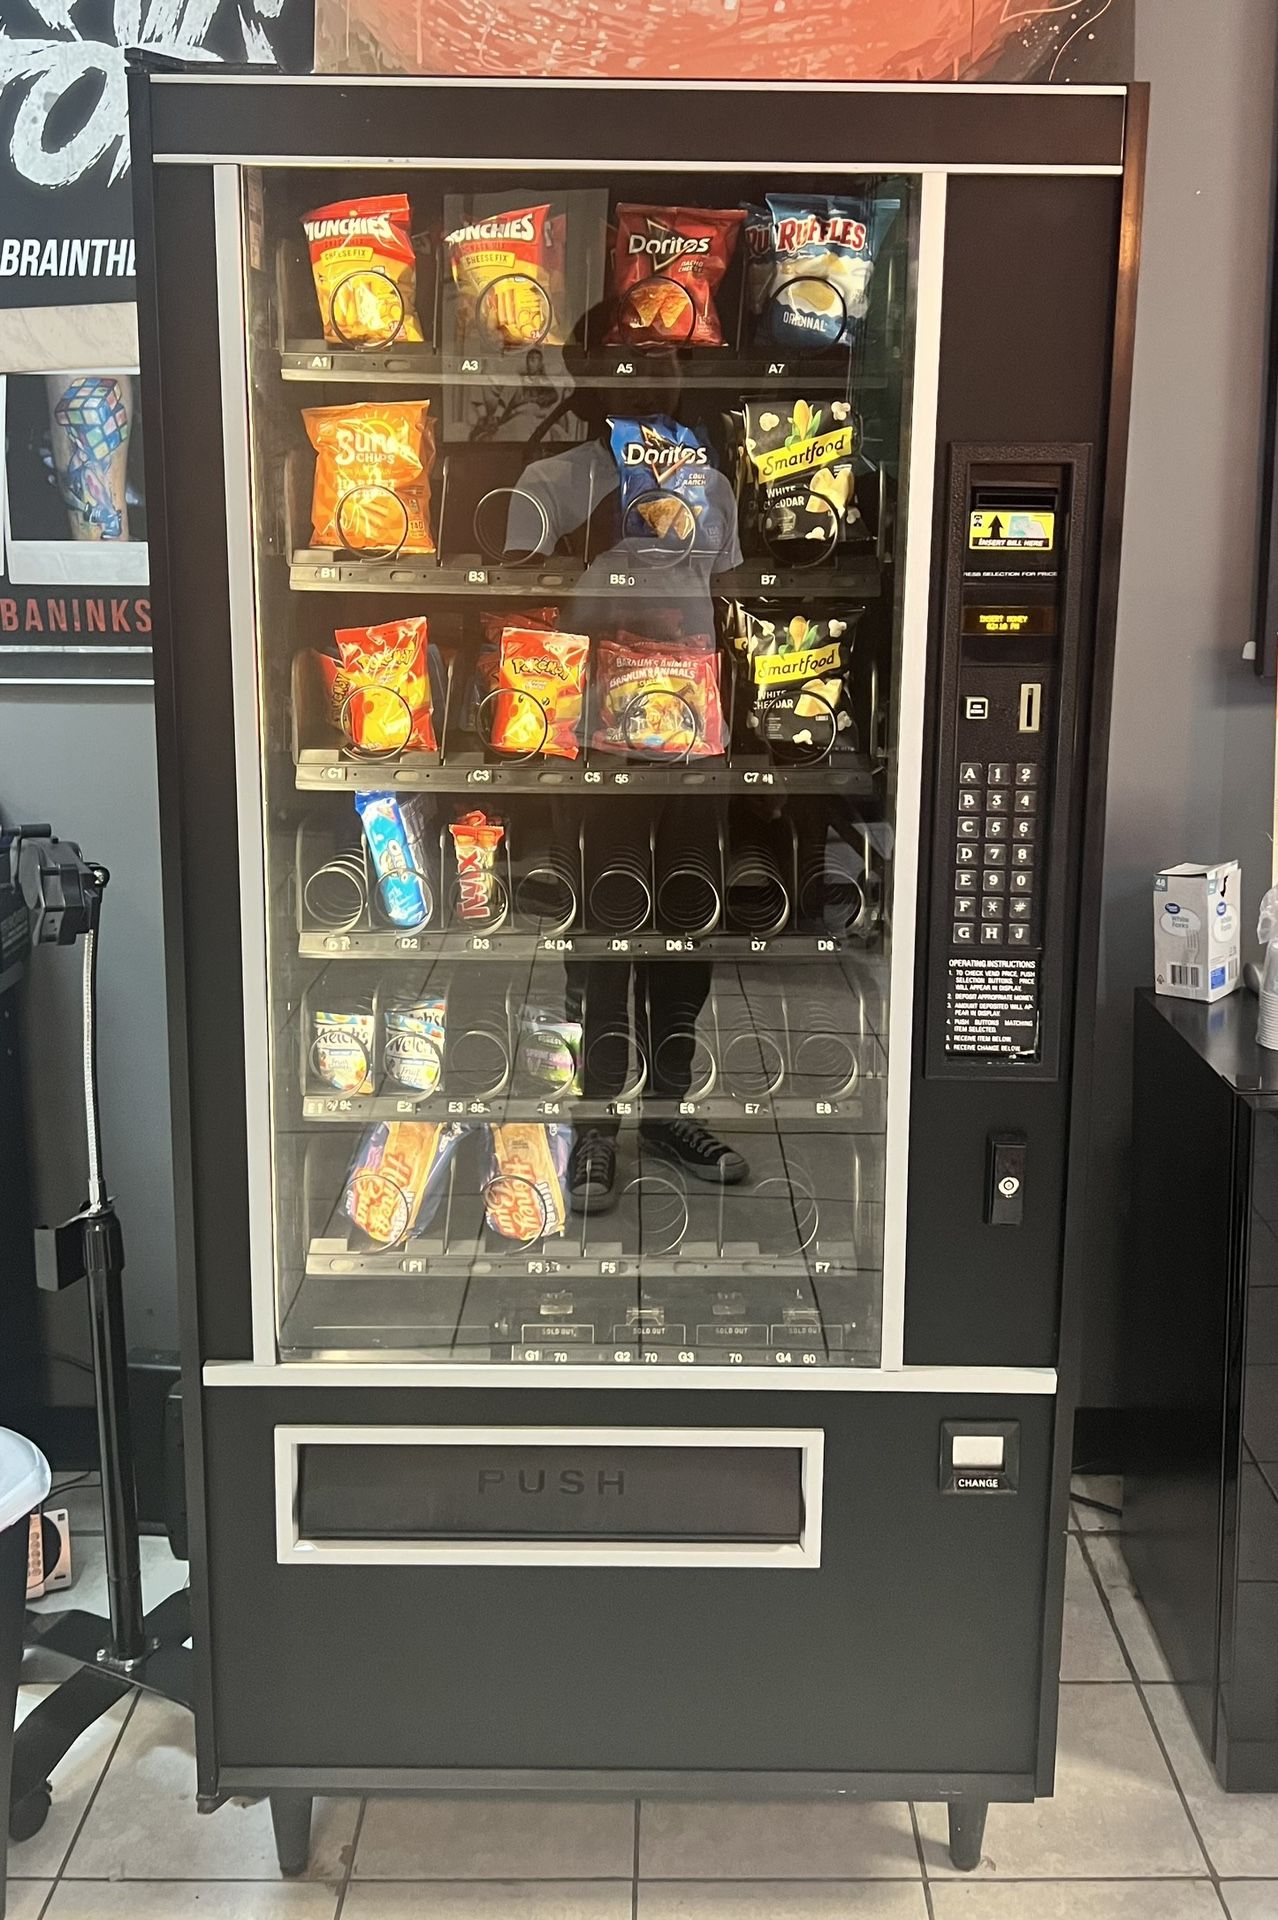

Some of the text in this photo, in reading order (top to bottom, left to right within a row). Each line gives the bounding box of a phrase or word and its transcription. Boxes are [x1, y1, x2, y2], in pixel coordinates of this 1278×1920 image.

[304, 213, 392, 241] MUNCHIES
[444, 213, 534, 243] UNCHIES
[776, 214, 866, 253] RUFFLES
[629, 234, 710, 254] Doritos
[353, 249, 366, 257] FIX
[466, 254, 507, 265] CHEESE FIX
[311, 357, 327, 368] A1
[462, 360, 479, 371] A3
[616, 363, 633, 374] A5
[768, 363, 785, 374] A7
[356, 454, 395, 464] CHIPS
[627, 444, 707, 466] Doritos
[763, 435, 845, 476] Smartfood
[978, 538, 1006, 546] INSERT
[321, 569, 335, 578] B1
[469, 571, 485, 582] B3
[610, 574, 625, 584] B5
[761, 575, 776, 585] B7
[2, 598, 152, 632] BANINKS
[1006, 615, 1028, 623] MONEY
[758, 650, 835, 678] Smartfood
[327, 768, 342, 778] C1
[473, 770, 489, 781] C3
[584, 772, 600, 783] C5
[744, 772, 758, 783] C7
[963, 768, 1031, 779] A 1 2
[963, 795, 1029, 806] B 3 4
[961, 821, 1028, 832] C 5 6
[961, 848, 1027, 859] D 7 8
[960, 874, 1026, 886] E 9 0
[959, 901, 971, 911] F
[958, 927, 1024, 939] G H J
[401, 939, 418, 949] D2
[473, 939, 490, 950] D3
[557, 940, 572, 950] D4
[612, 940, 628, 951] D5
[666, 940, 682, 950] D6
[751, 940, 767, 951] D7
[817, 940, 834, 950] D8
[949, 959, 1036, 969] OPERATING INSTRUCTIONS
[397, 1101, 412, 1111] E2
[448, 1102, 463, 1112] E3
[544, 1103, 560, 1114] E4
[617, 1103, 632, 1114] E5
[680, 1103, 696, 1114] E6
[745, 1103, 760, 1114] E7
[816, 1103, 832, 1114] E8
[409, 1262, 422, 1272] F1
[528, 1262, 542, 1273] F3
[601, 1262, 615, 1273] F5
[815, 1262, 830, 1273] F7
[652, 1327, 665, 1335] OUT
[525, 1351, 567, 1362] G1 70
[614, 1351, 658, 1362] G2 70
[678, 1351, 743, 1363] G3 70
[776, 1352, 816, 1364] G4 60
[478, 1469, 625, 1495] PUSH
[958, 1479, 999, 1488] CHANGE
